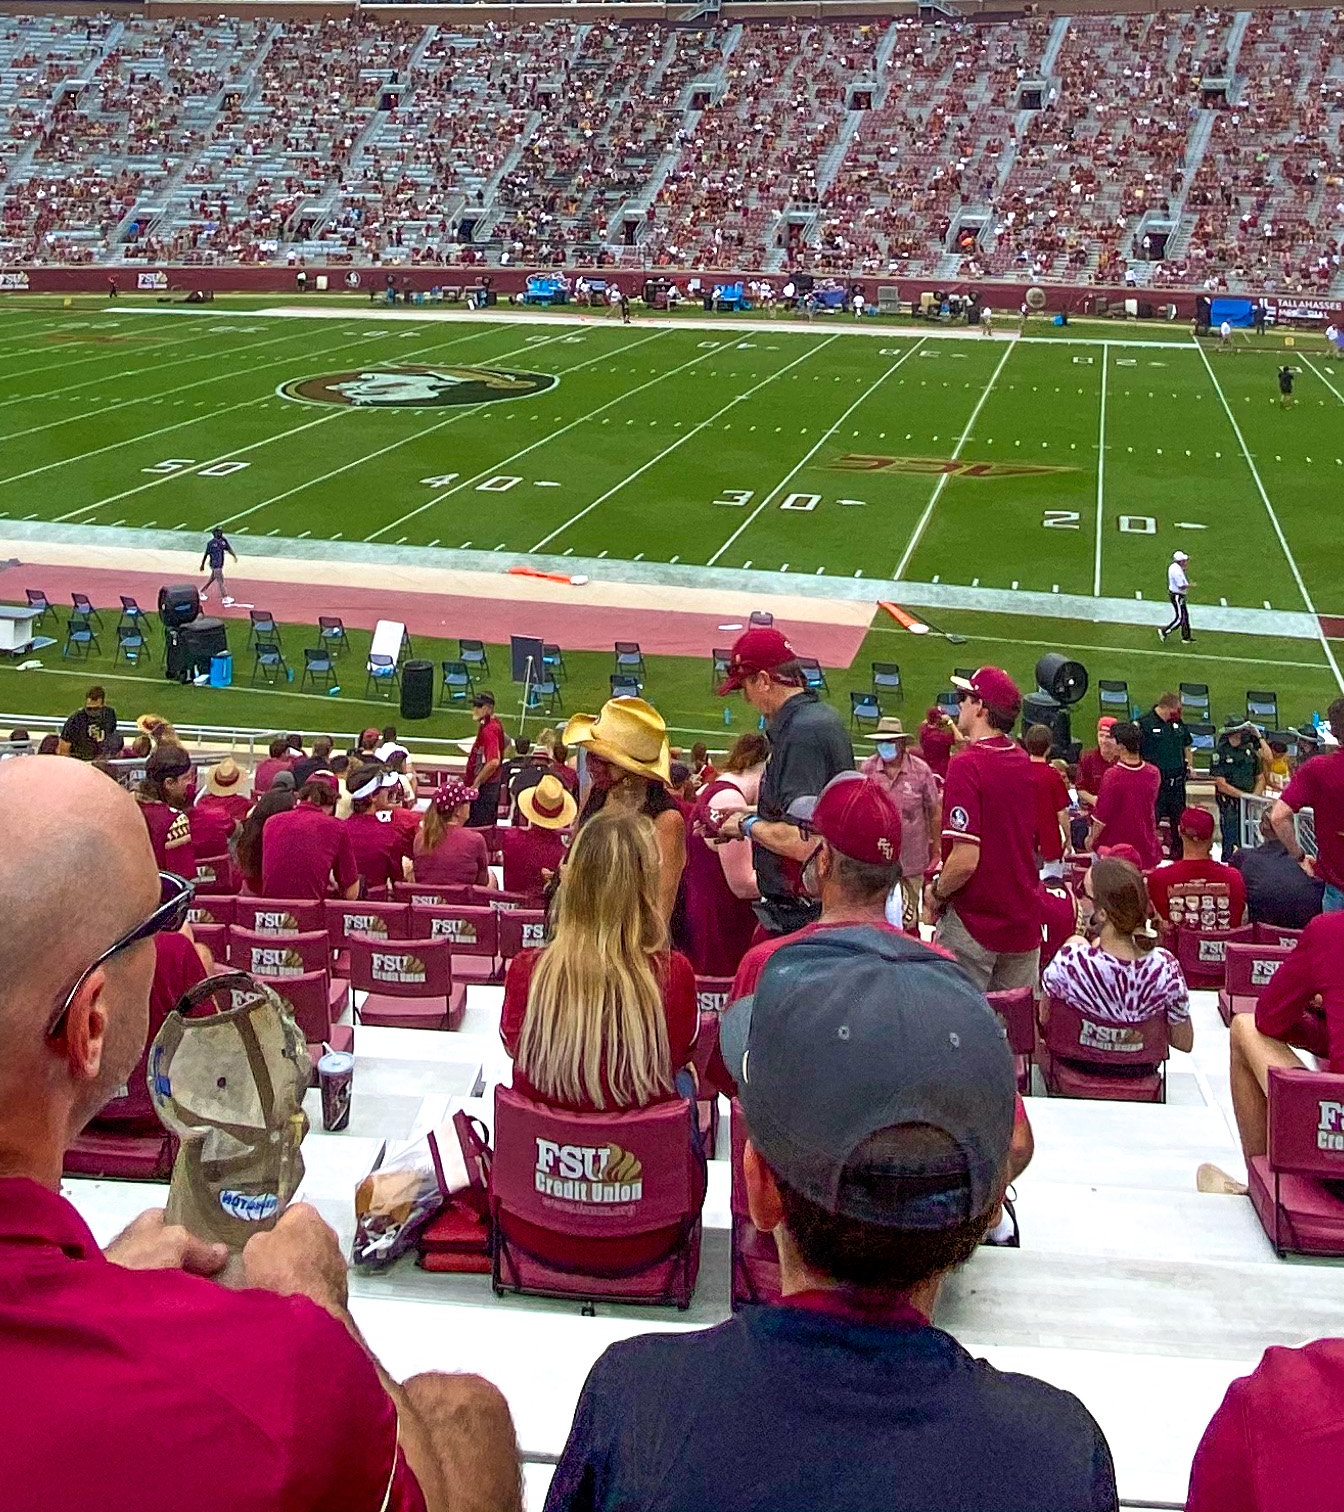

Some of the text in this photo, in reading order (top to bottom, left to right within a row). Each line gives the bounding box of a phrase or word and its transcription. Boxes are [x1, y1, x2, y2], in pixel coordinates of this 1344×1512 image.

[1277, 298, 1343, 312] TALLAHASSEE
[141, 458, 251, 477] 50
[421, 472, 524, 492] 40
[712, 489, 823, 511] 30
[1042, 509, 1157, 536] 20
[255, 912, 287, 931] FSU
[343, 915, 374, 933] FSU
[431, 919, 464, 935] FSU
[522, 924, 544, 939] FS
[251, 947, 288, 968] FSU
[371, 953, 407, 972] FSU
[697, 992, 728, 1011] SU
[1080, 1019, 1128, 1042] FSU
[534, 1137, 611, 1182] FSU
[534, 1174, 642, 1204] Credit Union
